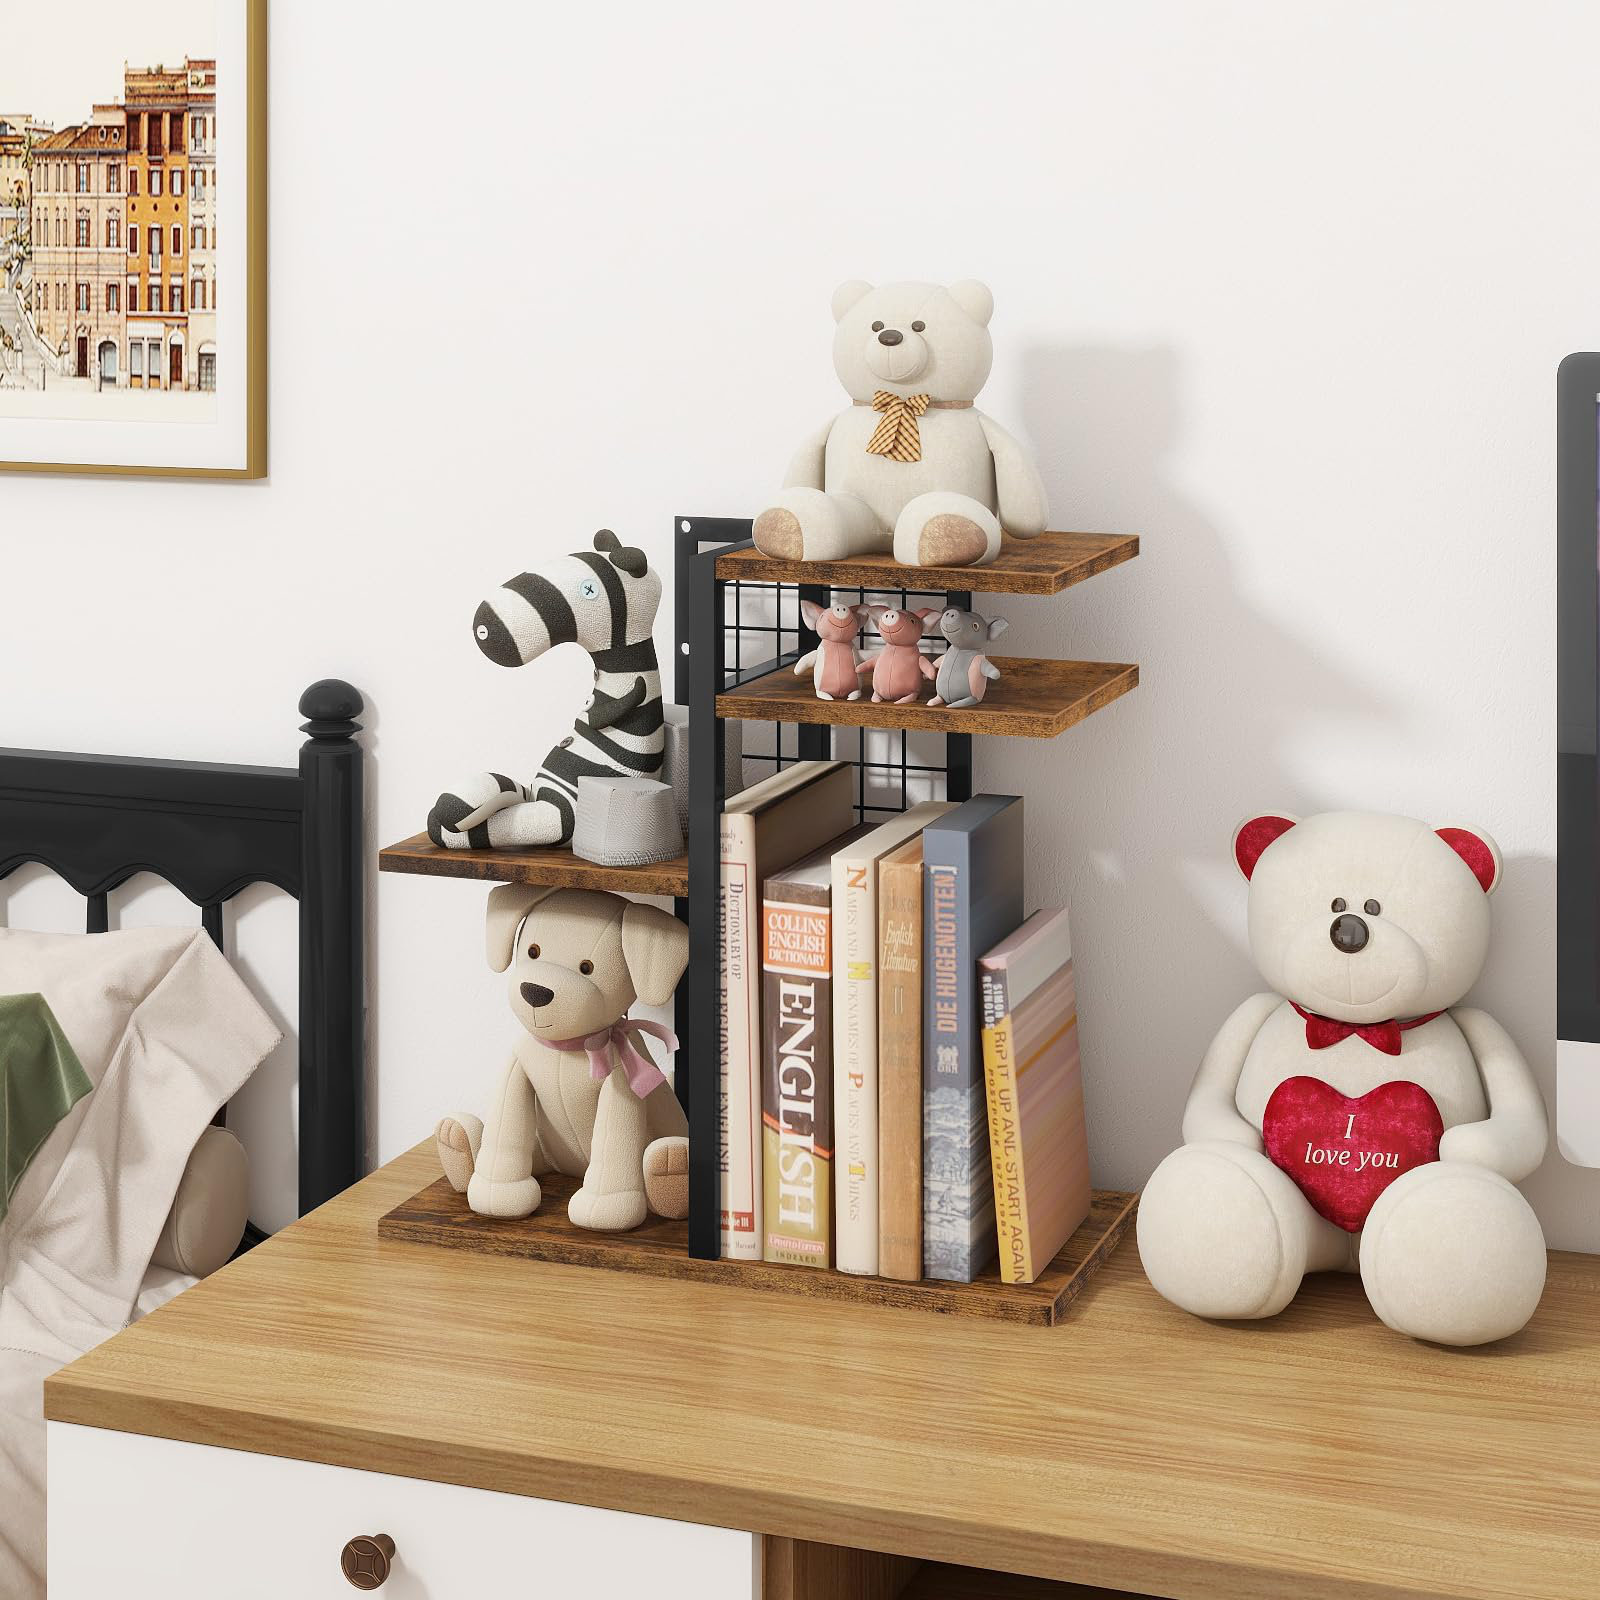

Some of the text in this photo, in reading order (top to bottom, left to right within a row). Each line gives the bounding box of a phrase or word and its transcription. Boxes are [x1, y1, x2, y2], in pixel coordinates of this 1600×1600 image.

[846, 865, 868, 925] NAMES
[729, 883, 744, 980] DICTIONARY OF
[767, 911, 827, 936] COLLINS
[885, 920, 914, 953] English
[767, 930, 827, 954] ENGLISH
[768, 947, 826, 967] DICTIONARY
[847, 928, 858, 958] AND
[881, 945, 919, 973] Literature
[847, 961, 873, 1049] NICKNAMES
[935, 1001, 959, 1033] DIE
[982, 975, 996, 1030] REYNOLDS
[992, 983, 1005, 1020] SIMON
[997, 1063, 1010, 1081] IT
[778, 977, 815, 1232] ENGLISH
[848, 1071, 865, 1129] PLACES
[998, 1088, 1012, 1113] UP
[1343, 1113, 1357, 1140] I
[848, 1131, 860, 1160] AND
[1304, 1142, 1400, 1173] love you
[848, 1160, 867, 1222] THINGS
[1005, 1161, 1022, 1221] START
[775, 1249, 818, 1265] INDEXED
[1010, 1225, 1026, 1283] AGAIN
